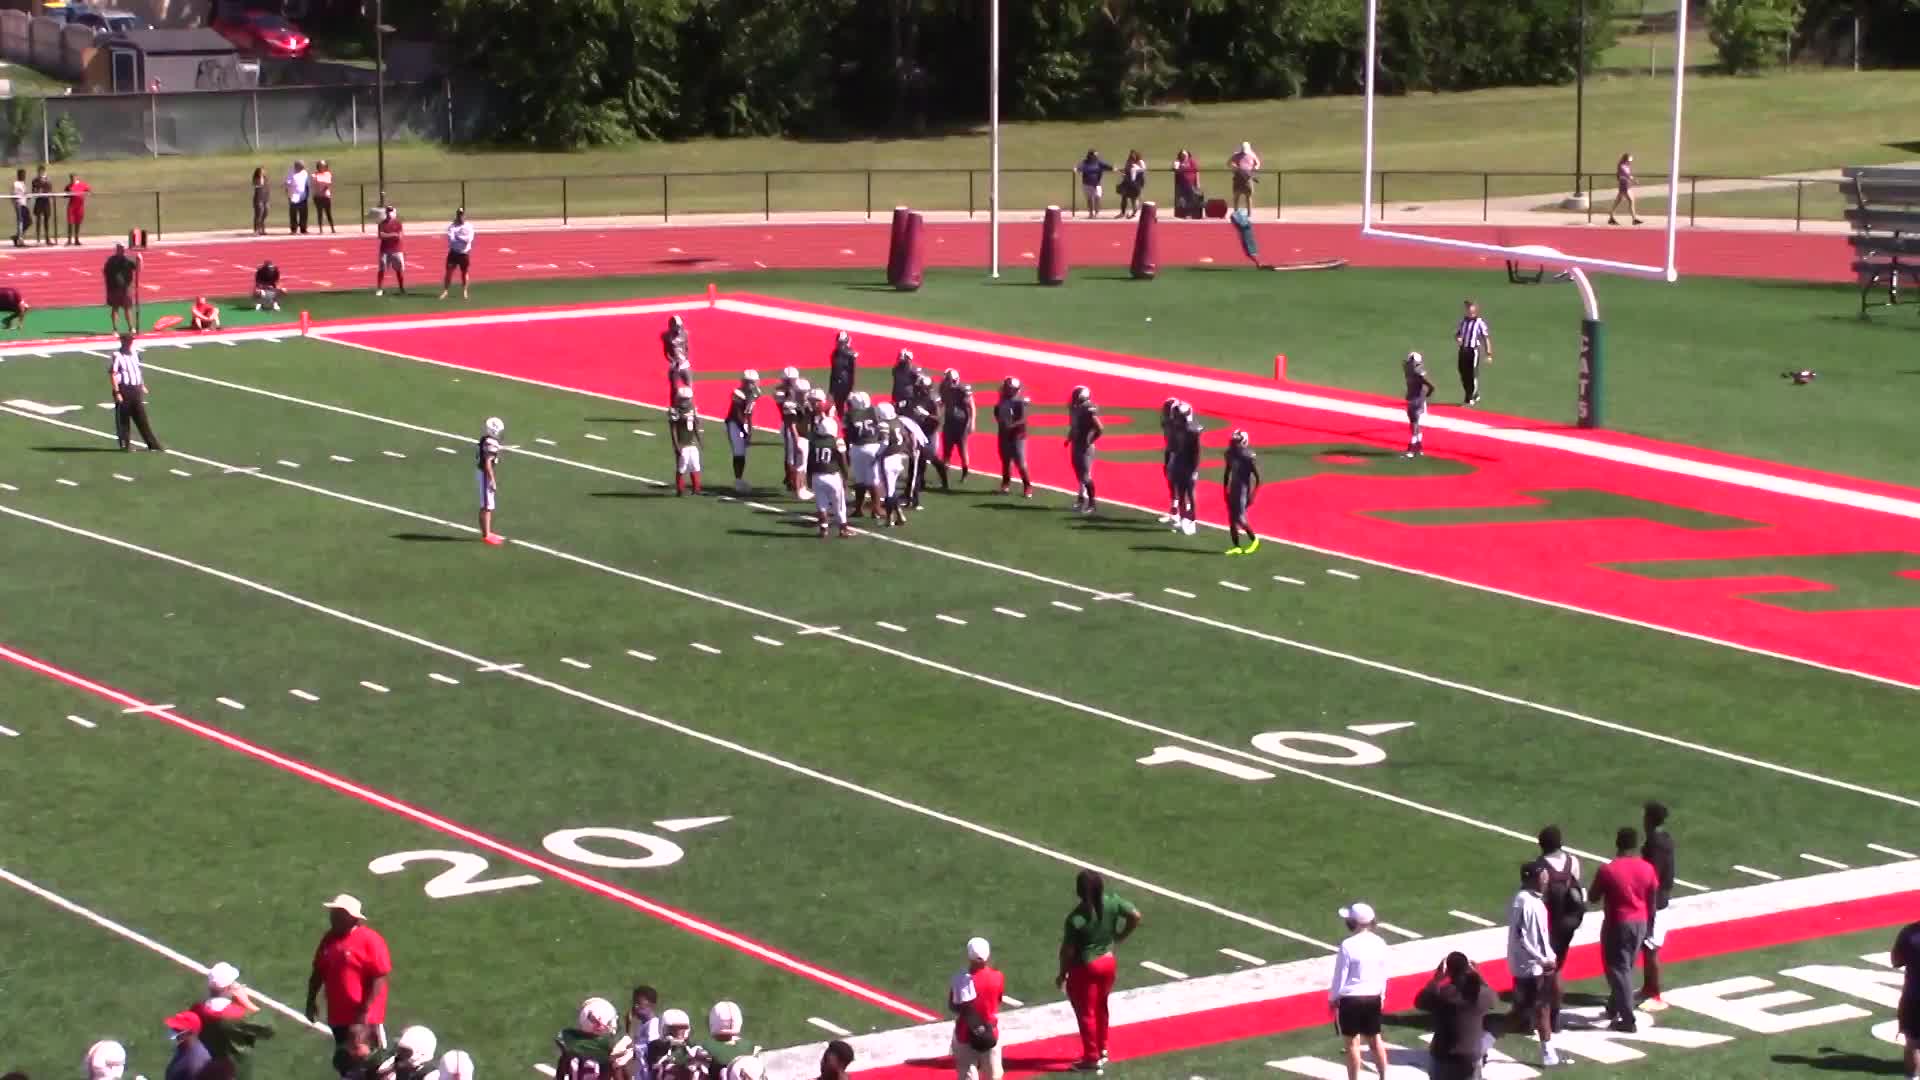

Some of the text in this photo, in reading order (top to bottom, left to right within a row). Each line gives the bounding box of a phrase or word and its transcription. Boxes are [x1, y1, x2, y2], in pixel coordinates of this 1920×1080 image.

[815, 447, 832, 464] 10
[1136, 731, 1387, 781] 10
[368, 827, 684, 899] 20
